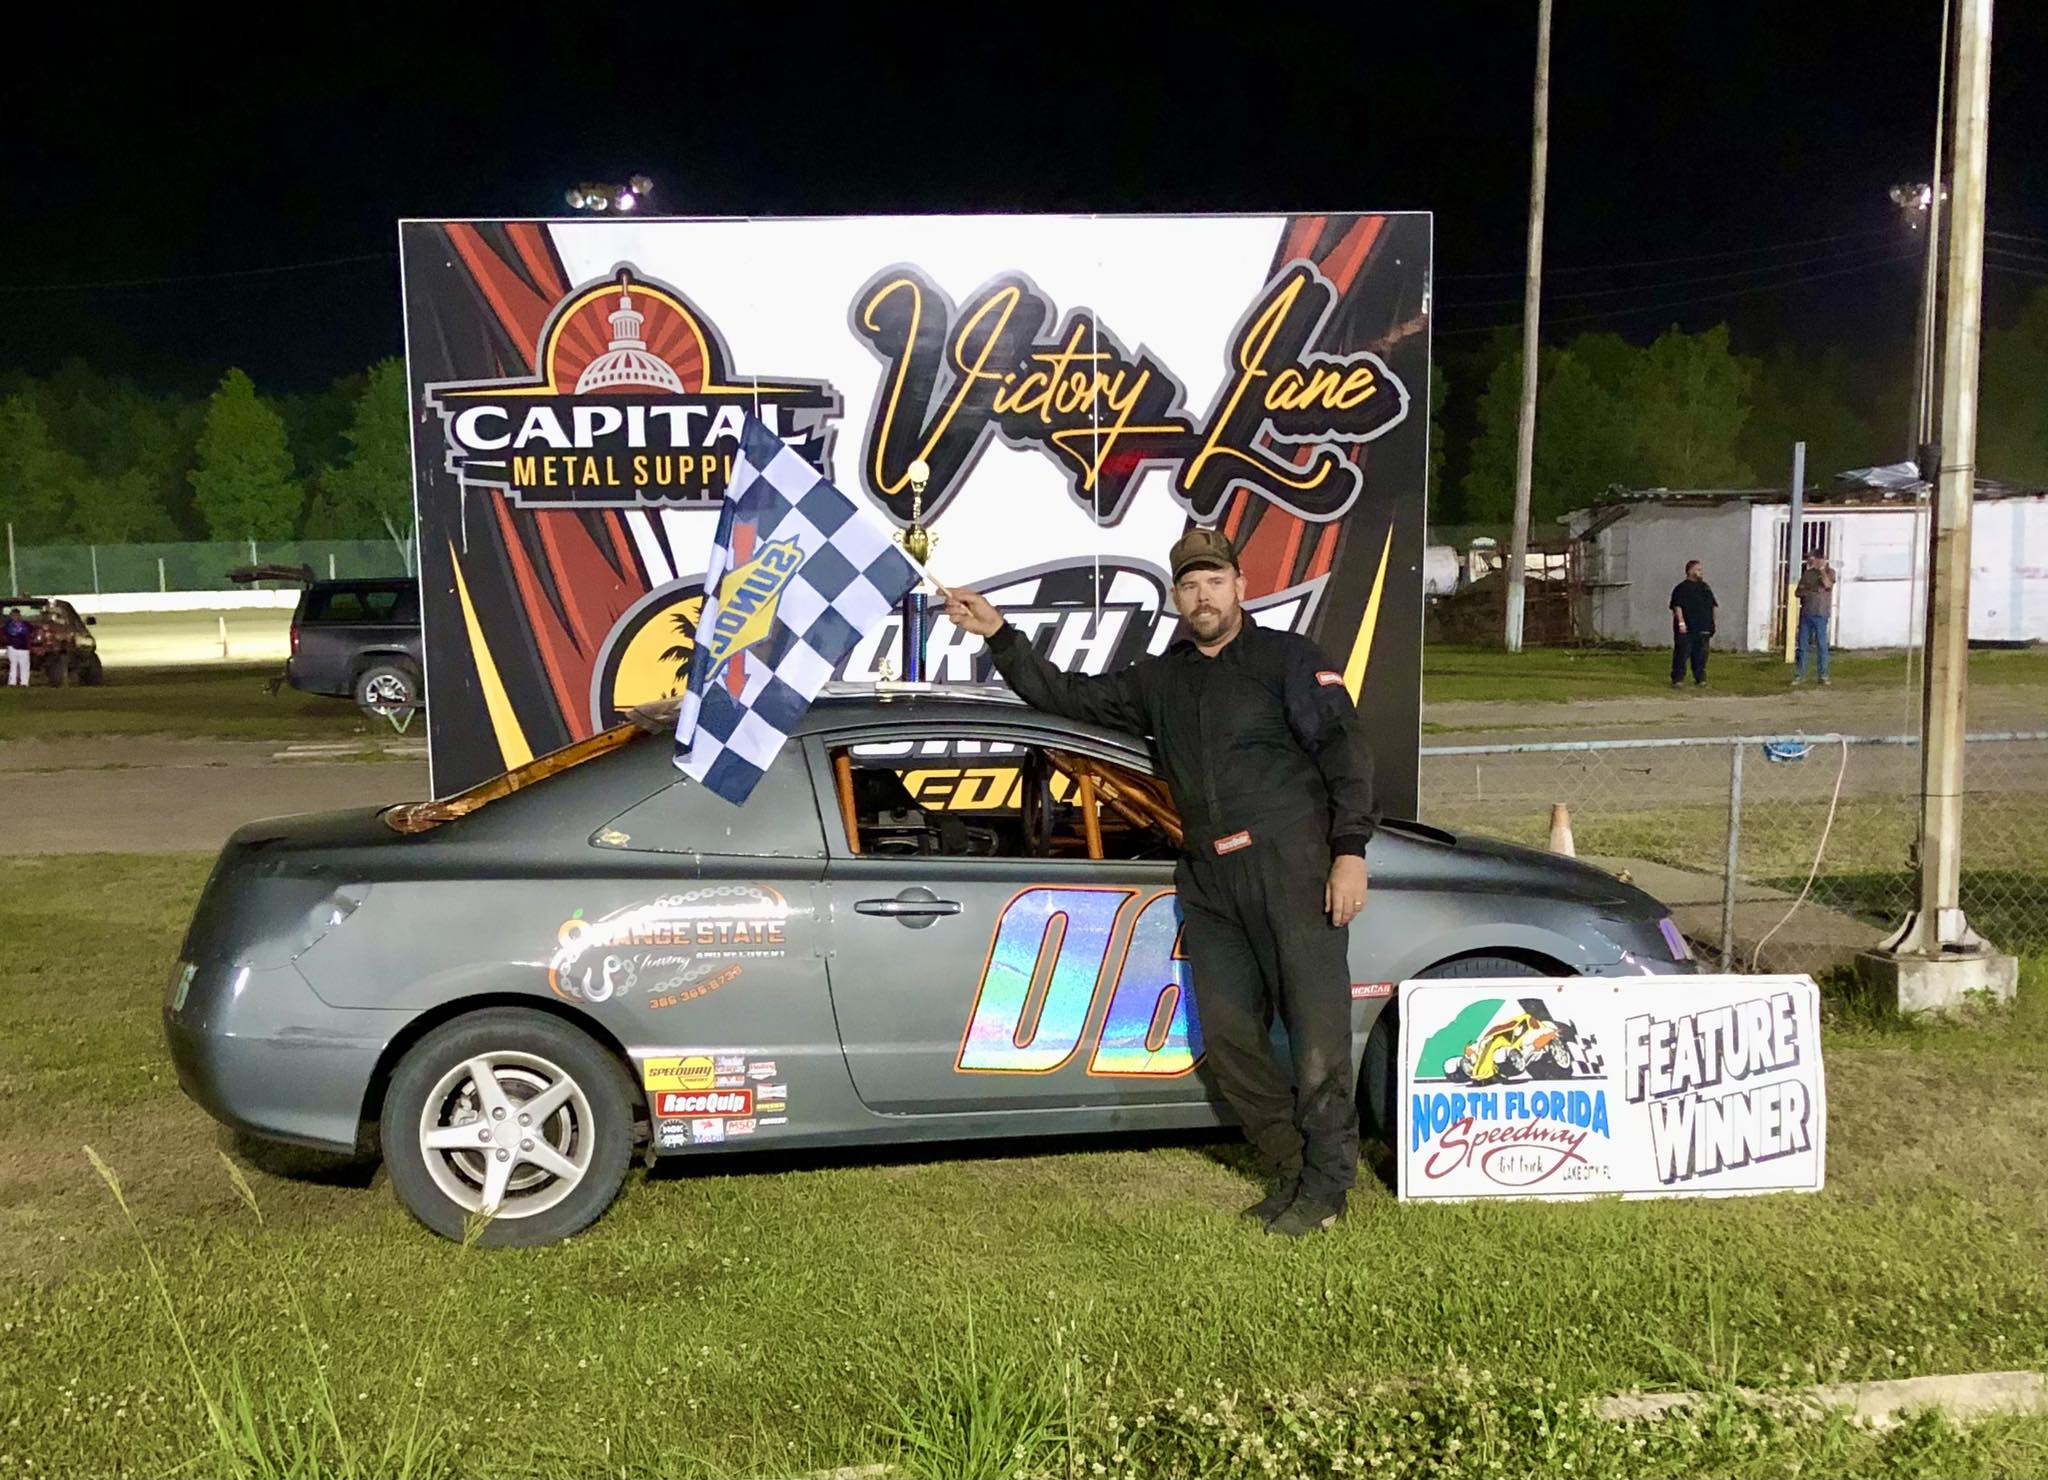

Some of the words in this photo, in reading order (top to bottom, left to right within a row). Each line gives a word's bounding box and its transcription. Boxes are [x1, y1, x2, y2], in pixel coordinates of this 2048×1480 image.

[864, 279, 1185, 494] Victory
[1184, 275, 1377, 490] Lane
[455, 404, 807, 450] CAPITAL
[513, 456, 620, 488] METAL
[696, 921, 786, 944] STATE
[1625, 992, 1800, 1104] FEATURE
[664, 1093, 745, 1114] RaceQuip
[1413, 1092, 1497, 1152] NORTH
[1505, 1090, 1610, 1139] FLORIDA
[1649, 1079, 1811, 1184] WINNER
[1425, 1115, 1588, 1187] Speedway
